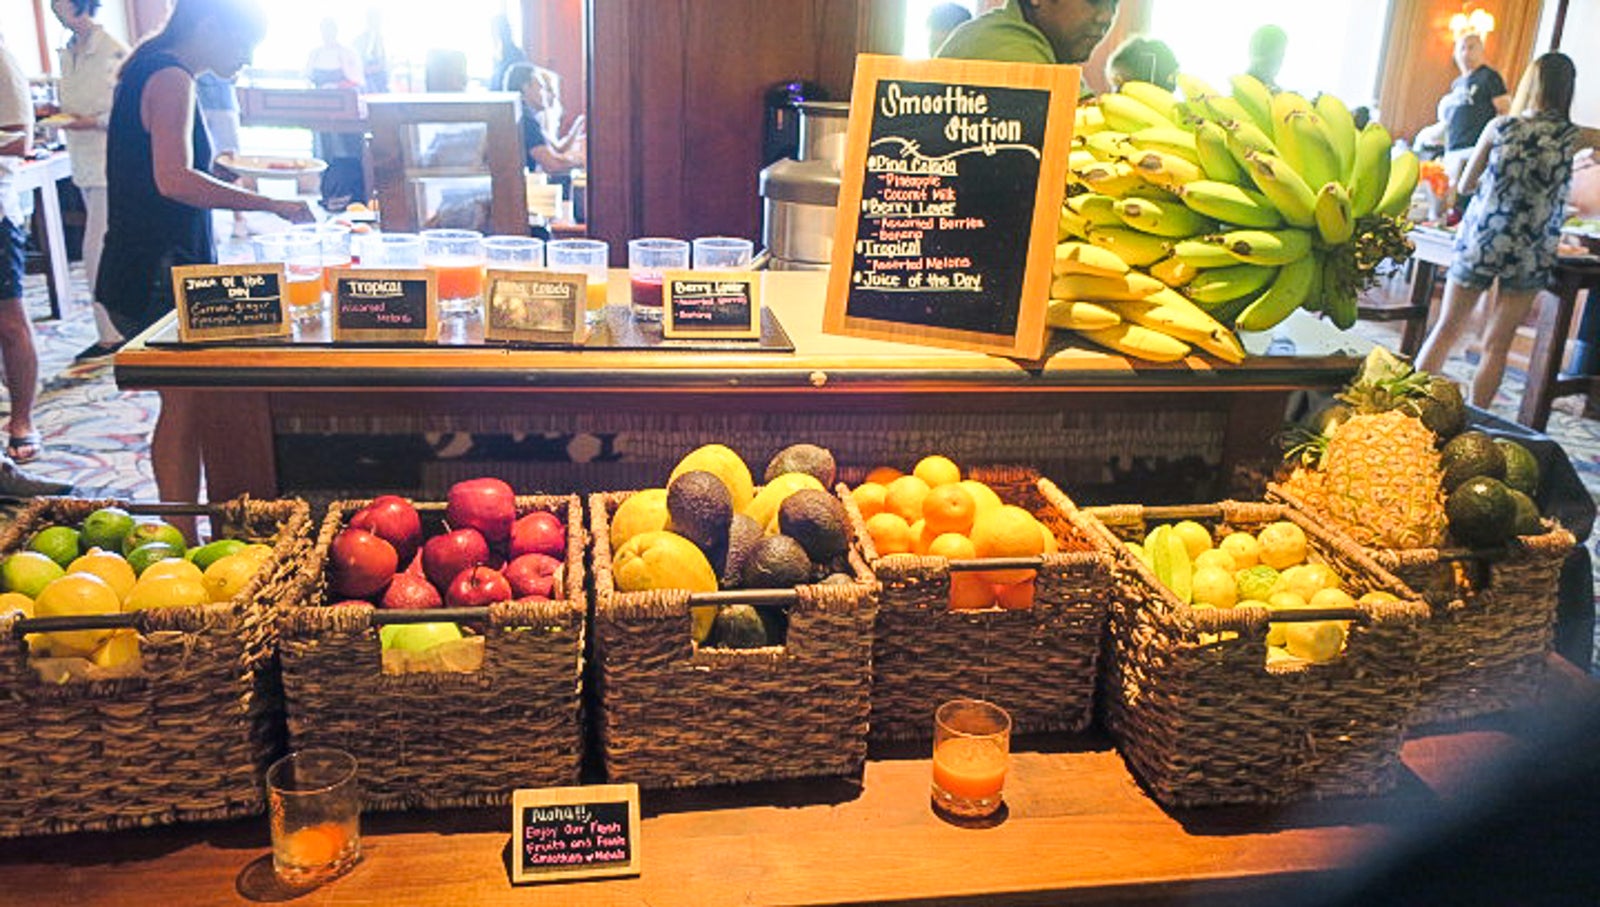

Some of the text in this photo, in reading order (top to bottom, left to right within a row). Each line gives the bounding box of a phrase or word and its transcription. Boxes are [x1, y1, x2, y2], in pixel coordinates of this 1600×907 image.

[882, 83, 988, 117] Smoothie
[945, 115, 1021, 142] Station
[932, 186, 956, 200] Milk
[870, 198, 956, 217] Berry Lover
[939, 217, 985, 229] Berries
[865, 239, 921, 257] Tropical
[926, 257, 972, 269] Melons
[347, 280, 403, 296] Tropical
[675, 281, 711, 294] Berry
[863, 271, 981, 291] Juice of the Day
[526, 826, 557, 841] Enjoy
[526, 840, 565, 854] Fruits
[571, 838, 592, 849] and
